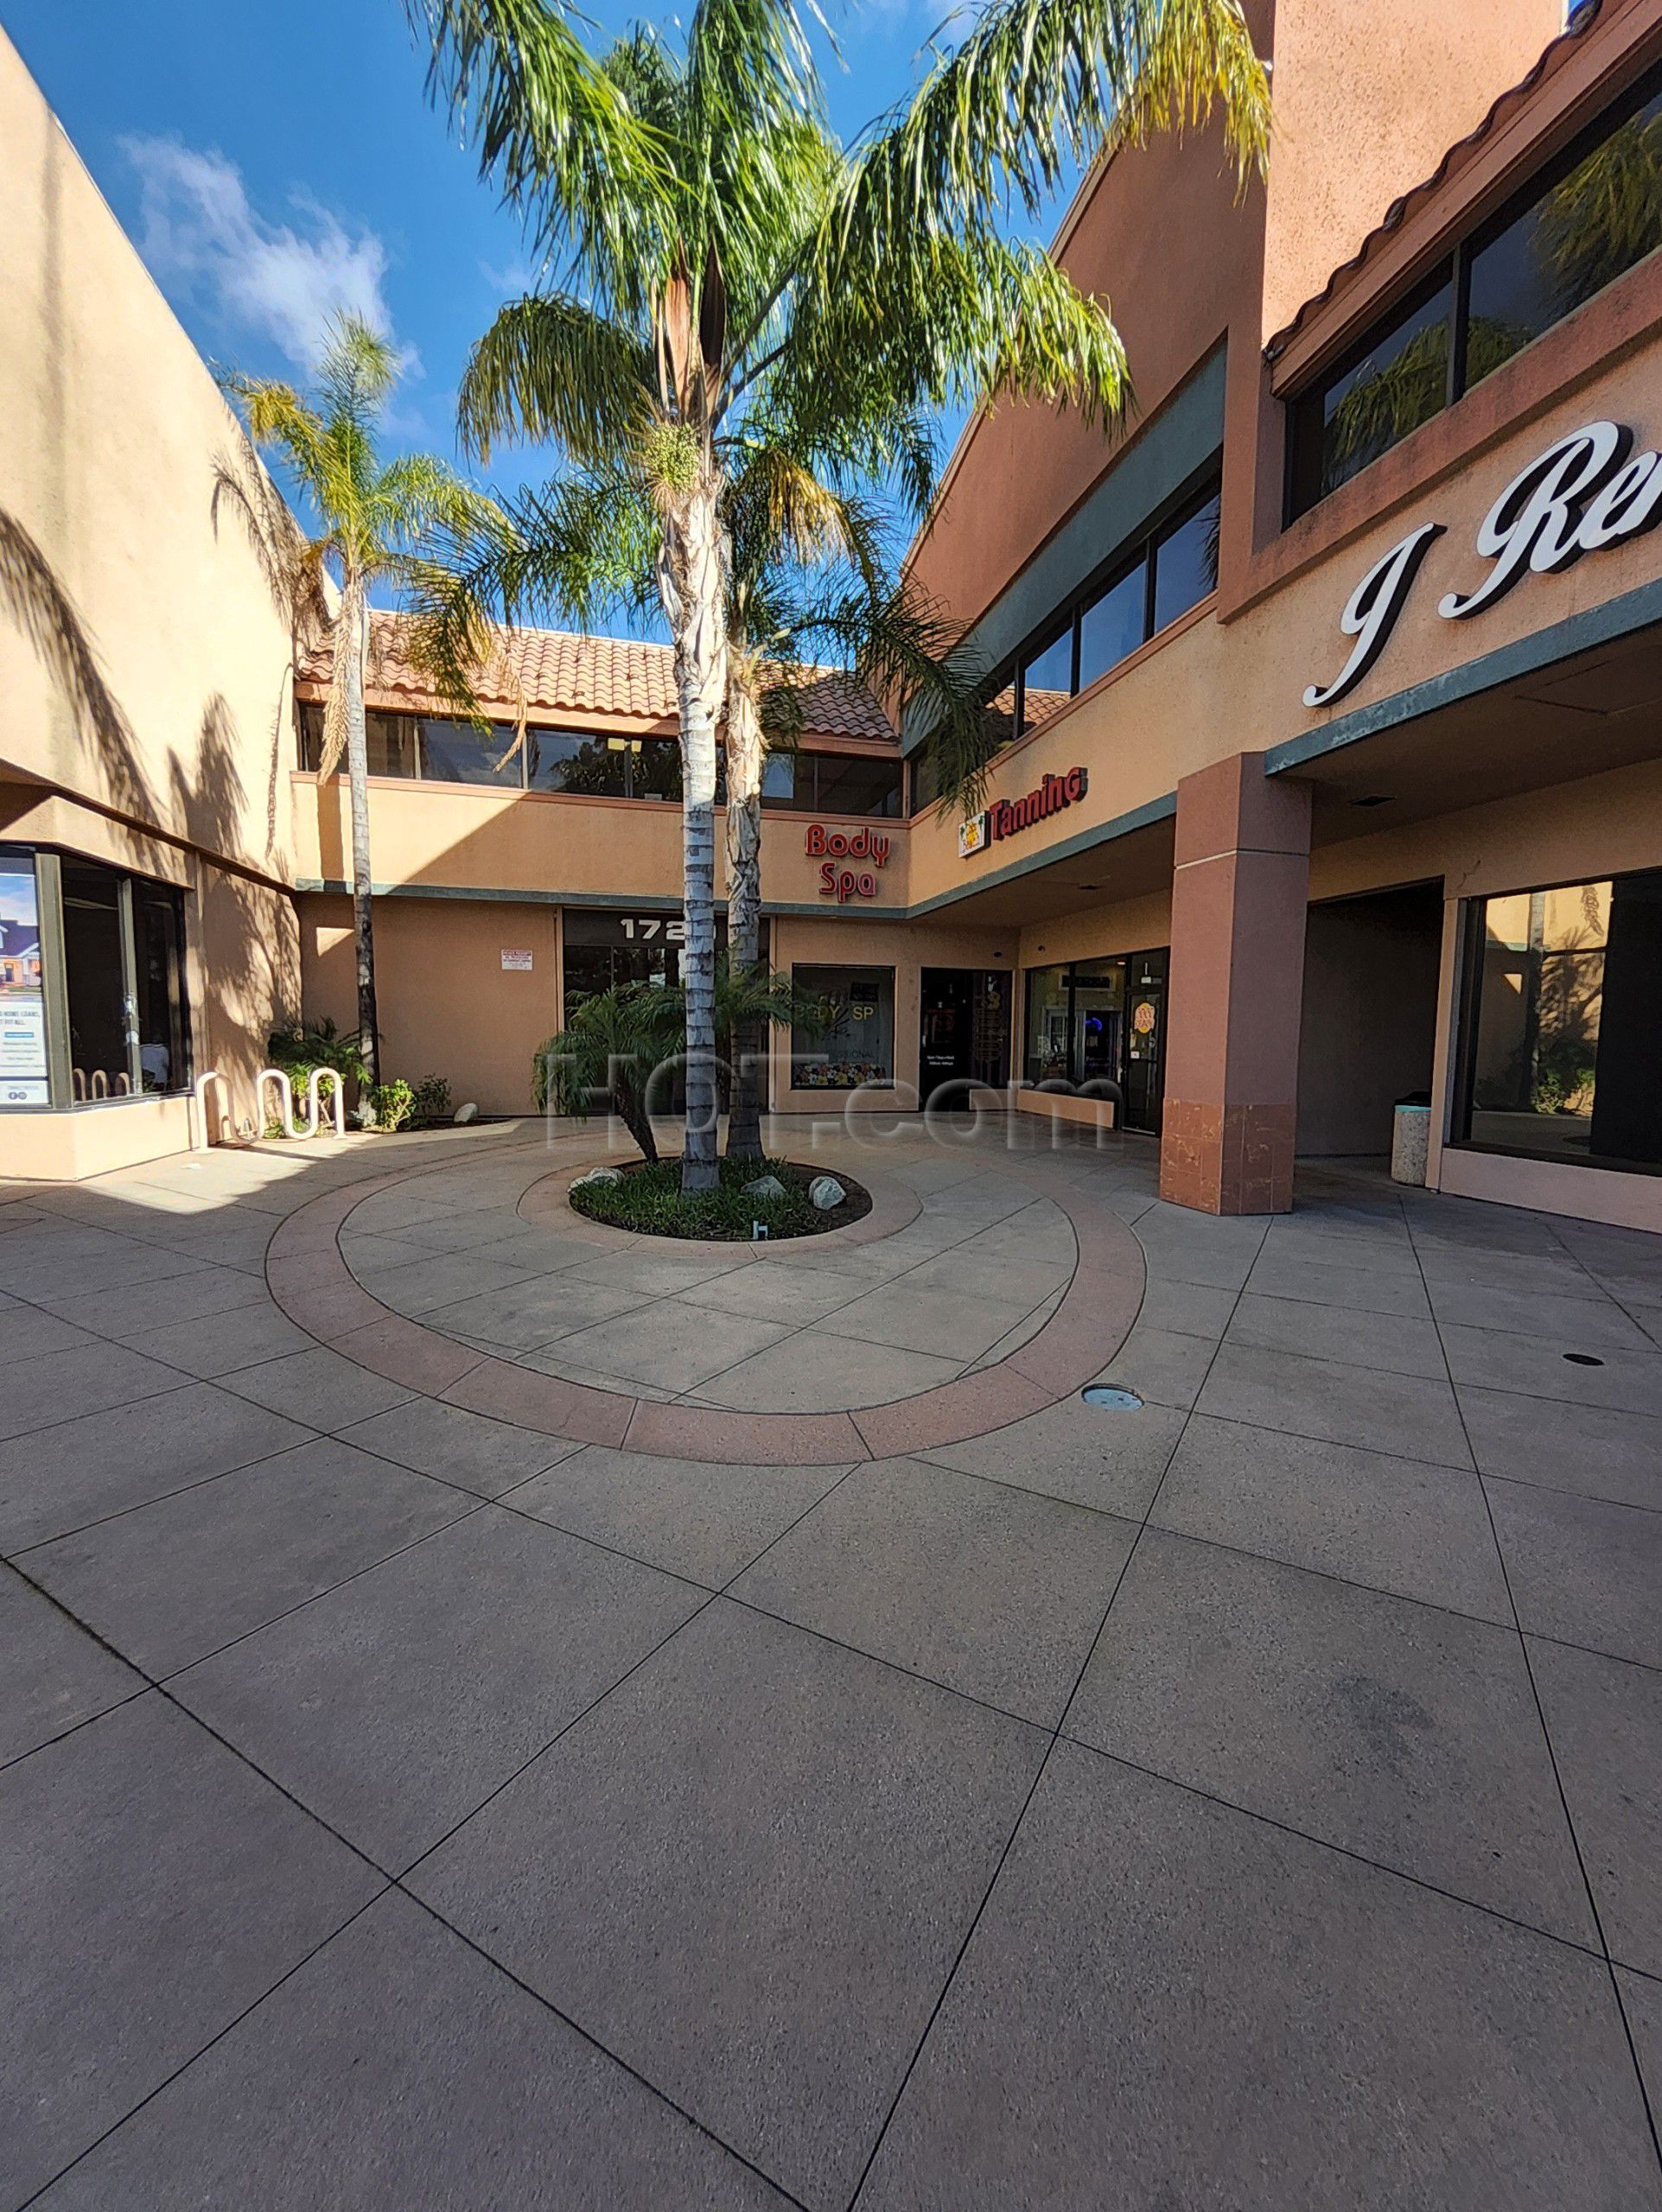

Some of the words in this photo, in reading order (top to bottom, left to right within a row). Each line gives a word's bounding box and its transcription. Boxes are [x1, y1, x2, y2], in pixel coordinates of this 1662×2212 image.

[806, 823, 888, 867] Body
[819, 862, 876, 902] Spa
[621, 918, 716, 941] 172
